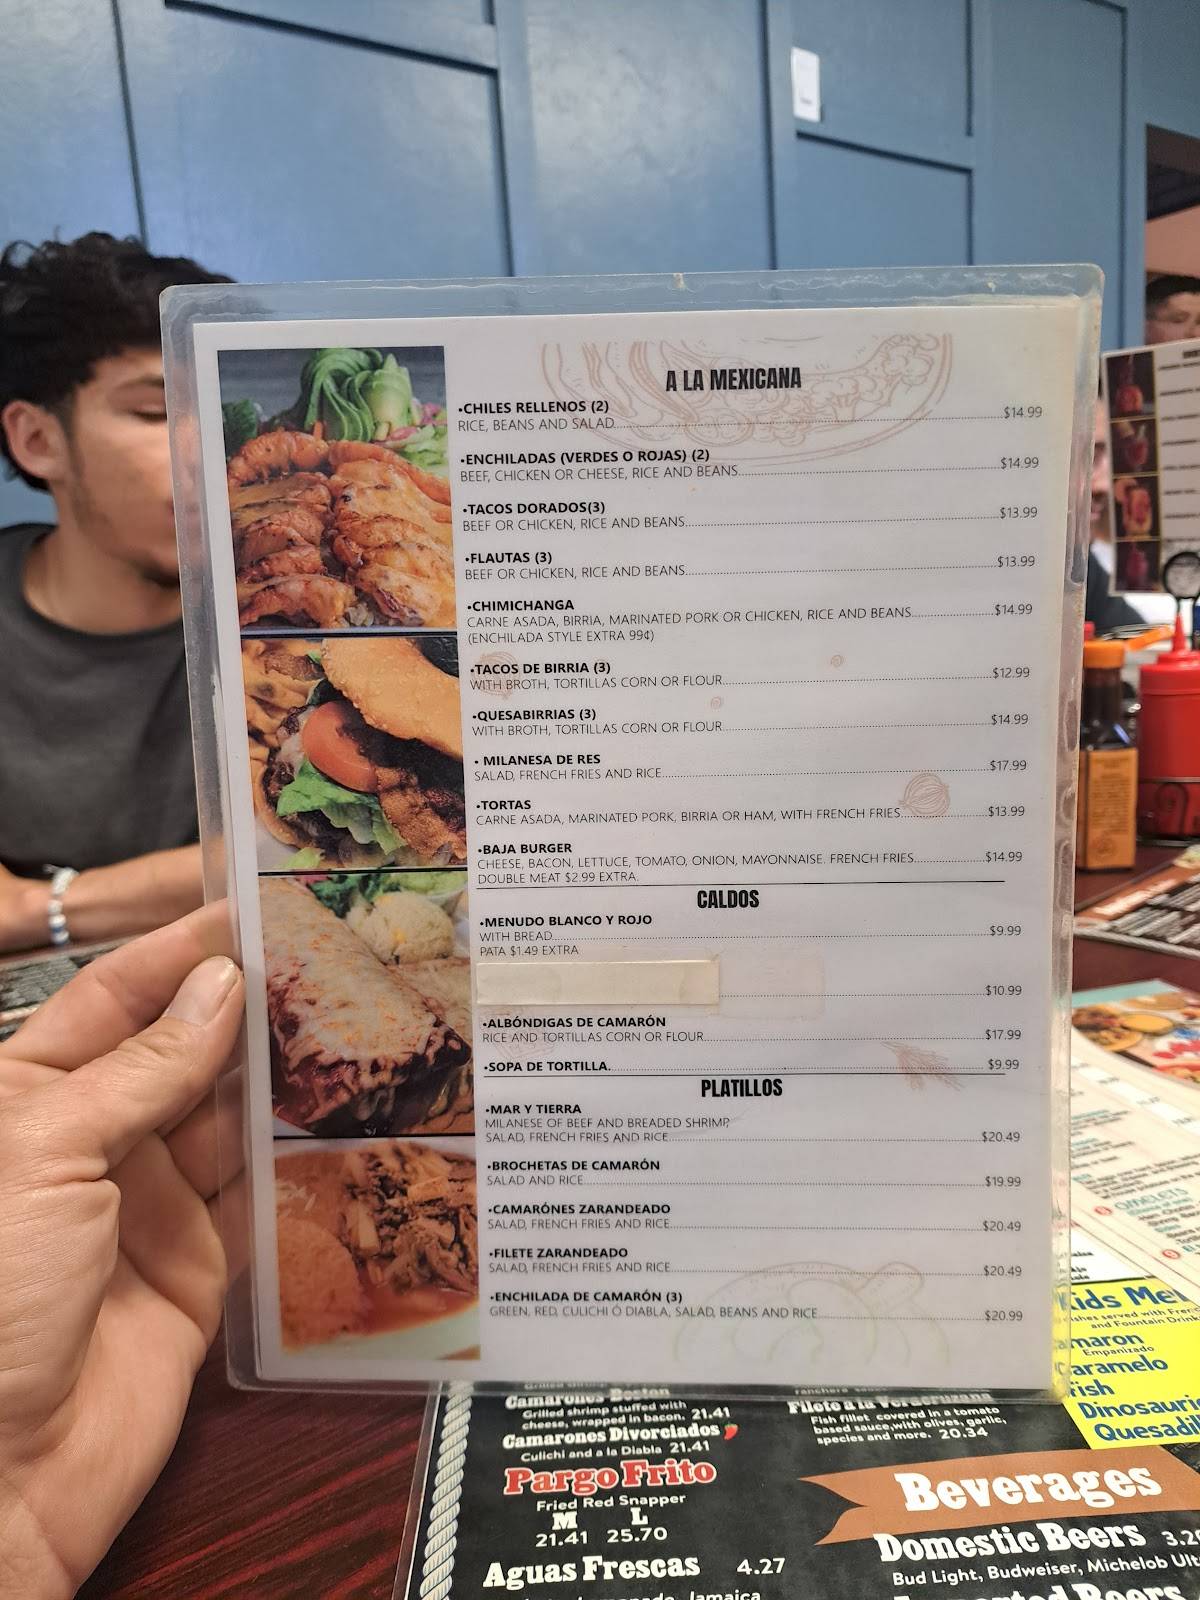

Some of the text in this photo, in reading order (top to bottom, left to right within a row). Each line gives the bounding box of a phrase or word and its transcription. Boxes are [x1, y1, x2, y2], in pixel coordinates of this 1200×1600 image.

[665, 366, 802, 392] A LA MEXICANA
[516, 400, 586, 414] RELLENOS
[590, 399, 609, 414] (2)
[458, 405, 1042, 433] RICE, BEANS AND SALAD $14.99
[560, 450, 618, 465] (VERDES
[622, 450, 633, 462] O
[638, 449, 686, 463] ROJAS)
[691, 449, 710, 462] (2)
[460, 456, 1039, 483] BEEF, CHICKEN OR CHEESE, RICE AND BEANS $14.99
[517, 501, 605, 516] DORADOS(3)
[534, 551, 552, 565] (3)
[466, 603, 1032, 629] CARNE ASADA, BIRRIA, MARINATED PORK OR CHICKEN, RICE AND BEANS $14.99
[468, 631, 544, 645] (ENCHILADA
[547, 630, 582, 642] STYLE
[586, 630, 625, 642] EXTRA
[522, 663, 540, 674] DE
[544, 662, 589, 674] BIRRIA
[593, 661, 610, 675] (3)
[469, 666, 1030, 691] WITH BROTH, TORTILLAS CORN OR FLOUR $12.99
[579, 708, 596, 721] (3)
[483, 754, 600, 766] MILANESA DE RES
[474, 759, 1026, 782] SALAD, FRENCH FRIES AND RICE $17.99
[520, 843, 572, 854] BURGER
[696, 889, 760, 908] CALDOS
[548, 915, 602, 926] BLANCO
[605, 915, 614, 925] Y
[618, 914, 652, 925] ROJO
[479, 925, 1021, 942] WITH BREAD $9.99
[480, 944, 579, 958] PATA $1.49 EXTRA
[984, 984, 1022, 996] $10.99
[576, 1017, 593, 1027] DE
[596, 1014, 666, 1027] CAMARÓN
[526, 1061, 542, 1071] DE
[987, 1058, 1019, 1070] $9.99
[701, 1078, 782, 1097] PLATILLOS
[524, 1104, 532, 1114] Y
[535, 1104, 582, 1114] TIERRA
[571, 1160, 588, 1170] DE
[591, 1157, 660, 1171] CAMARÓN
[578, 1203, 670, 1214] ZARANDEADO
[573, 1291, 589, 1302] DE
[593, 1288, 661, 1302] CAMARÓN
[666, 1292, 682, 1304] (3)
[1083, 1345, 1155, 1356] Empanizado
[522, 1401, 686, 1419] Grilled shrimp stuffed with
[572, 1416, 625, 1428] wrapped
[629, 1414, 640, 1423] in
[644, 1412, 685, 1422] bacon.
[691, 1407, 730, 1420] 21.41
[811, 1416, 836, 1425] Fish
[876, 1411, 926, 1421] covered
[929, 1410, 941, 1418] in
[944, 1409, 951, 1417] a
[954, 1406, 999, 1415] tomato
[503, 1423, 720, 1449] Camarones Divorciados
[939, 1428, 988, 1440] 20.34
[521, 1440, 710, 1462] Culichi and a la Diabla 21.41
[504, 1458, 717, 1495] Pargo Frito
[894, 1466, 1163, 1512] Beverages
[537, 1493, 686, 1512] Fried Red Snapper
[552, 1507, 648, 1530] M L
[535, 1527, 668, 1547] 21.41 25.70
[873, 1527, 1038, 1562] Domestic
[1036, 1522, 1147, 1551] Beers
[483, 1555, 785, 1590] Aguas Frescas 4.27
[892, 1556, 1169, 1586] Bud Light, Budweiser, Michelob
